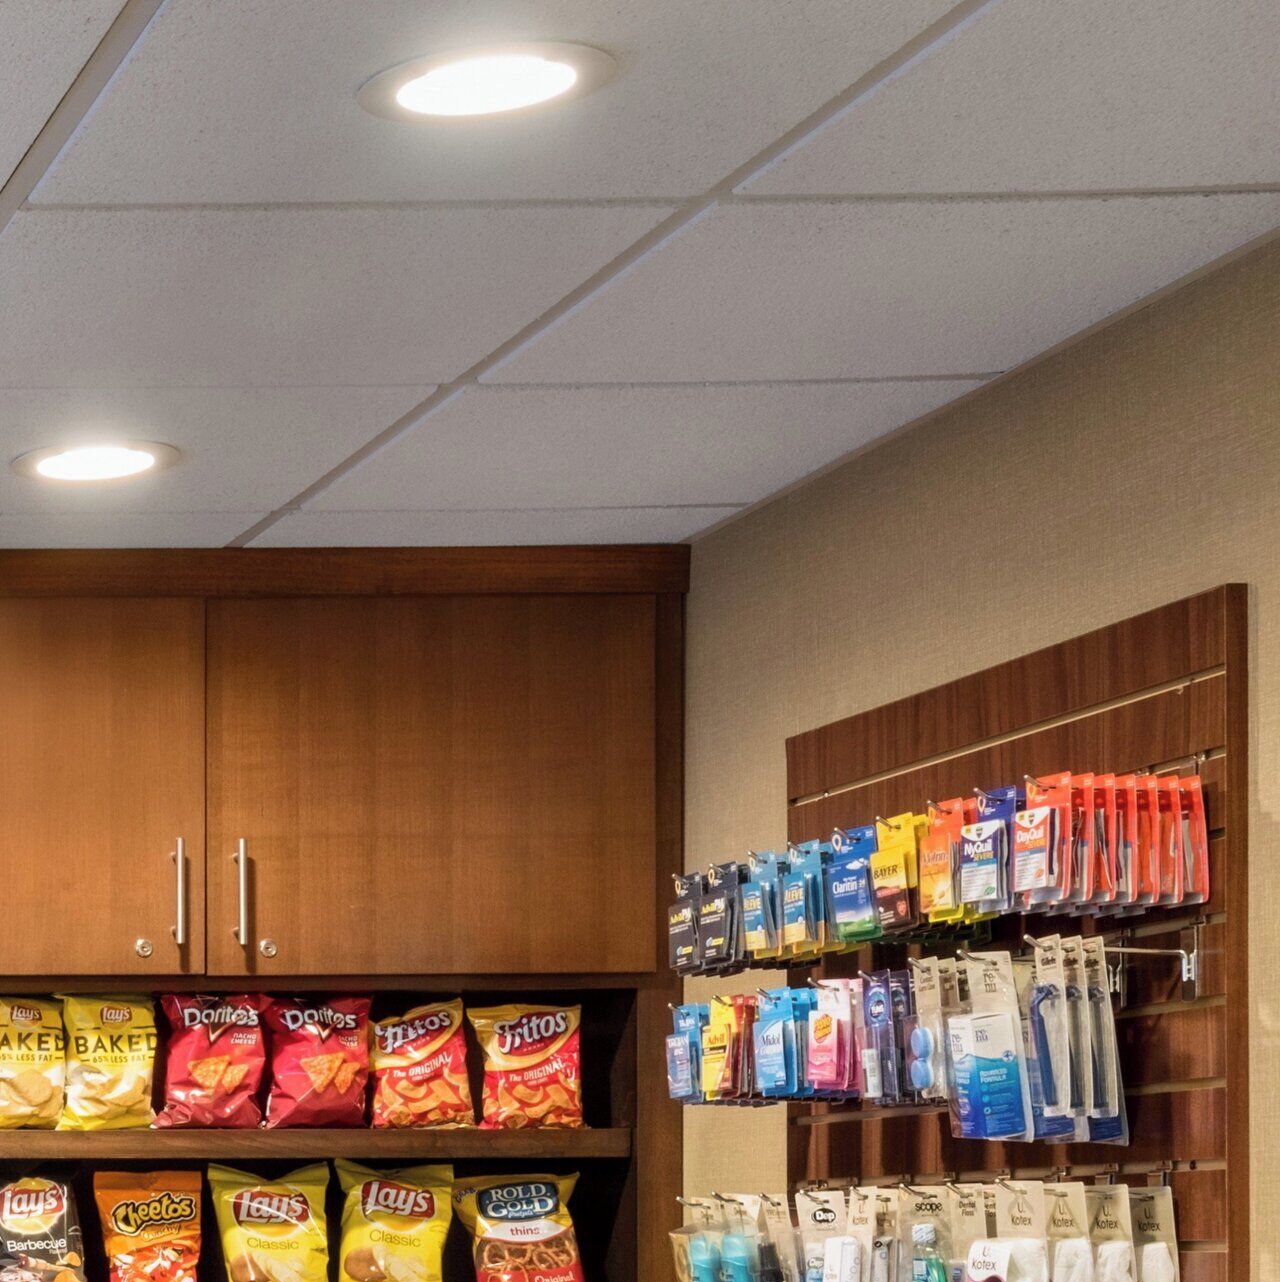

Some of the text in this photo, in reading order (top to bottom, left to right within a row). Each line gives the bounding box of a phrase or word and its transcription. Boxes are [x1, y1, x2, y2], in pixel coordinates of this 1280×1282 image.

[1016, 827, 1044, 843] DayQuil
[964, 840, 993, 856] NyQuil
[873, 864, 898, 880] BAYER
[833, 880, 858, 893] Claritin
[11, 1007, 40, 1022] Lay's
[101, 1008, 131, 1022] Lay's
[184, 1008, 259, 1030] Doritos
[285, 1009, 356, 1031] Doritos
[374, 1012, 452, 1054] Fritos
[493, 1010, 567, 1053] Fritos
[708, 1034, 725, 1044] Advil
[762, 1033, 781, 1046] Midol
[74, 1033, 157, 1055] BAKED
[230, 1038, 257, 1046] CHEESE
[16, 1054, 34, 1062] LESS
[37, 1054, 53, 1062] FAT
[365, 1182, 432, 1215] Lay's
[490, 1184, 546, 1202] ROLD
[2, 1186, 60, 1218] Lay's
[238, 1191, 305, 1225] Lay's
[485, 1195, 555, 1219] GOLD
[113, 1194, 196, 1235] Cheetos
[1011, 1215, 1032, 1226] kotex
[1052, 1216, 1075, 1228] kotex
[7, 1237, 67, 1252] Barbecue
[246, 1236, 300, 1251] Classic
[369, 1229, 422, 1248] Classic
[972, 1260, 996, 1271] kotex
